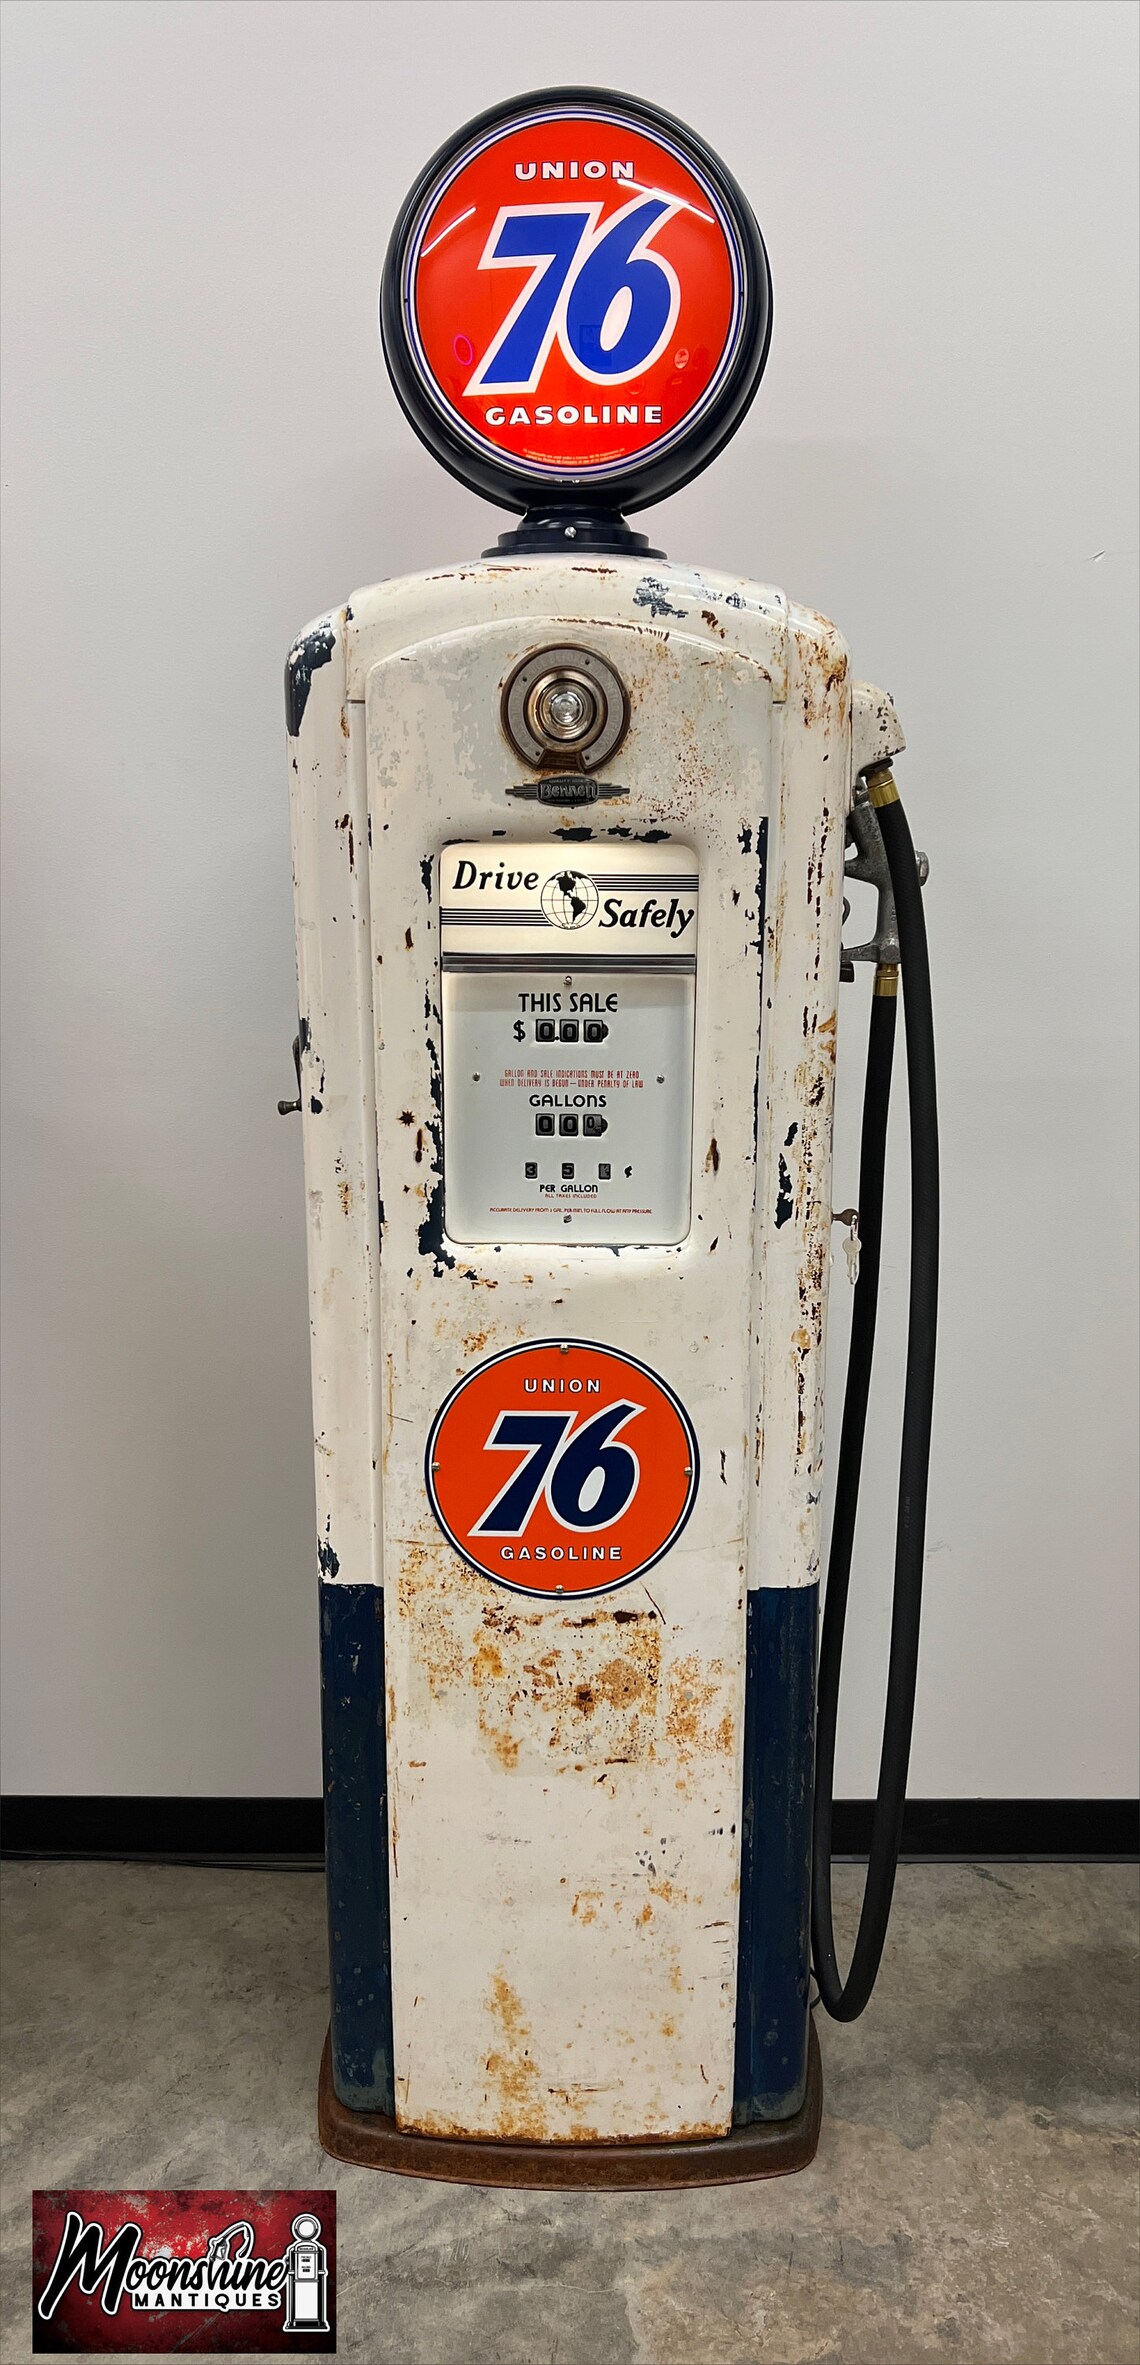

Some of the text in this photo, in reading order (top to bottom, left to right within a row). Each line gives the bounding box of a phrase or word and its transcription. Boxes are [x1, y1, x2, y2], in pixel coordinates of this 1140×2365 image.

[514, 160, 635, 181] UNION
[462, 187, 682, 397] 76
[484, 404, 663, 426] GASOLINE
[452, 860, 539, 890] Drive
[598, 899, 695, 938] Safely
[518, 993, 618, 1012] THIS SALE
[513, 1020, 526, 1042] $
[518, 1079, 541, 1087] DELIVERY
[597, 1080, 620, 1088] PENALTY
[623, 1080, 629, 1088] OF
[632, 1080, 643, 1088] LAW
[541, 1070, 553, 1078] SALE
[556, 1070, 588, 1078] INDICATIONS
[591, 1070, 604, 1078] MUST
[607, 1070, 613, 1078] BE
[626, 1071, 639, 1079] ZERO
[529, 1094, 607, 1108] GALLONS
[525, 1163, 538, 1179] 3
[561, 1163, 575, 1180] 5
[540, 1184, 598, 1193] PER GALLON
[524, 1379, 600, 1393] UNION
[467, 1399, 647, 1537] 76
[501, 1546, 622, 1560] GASOLINE
